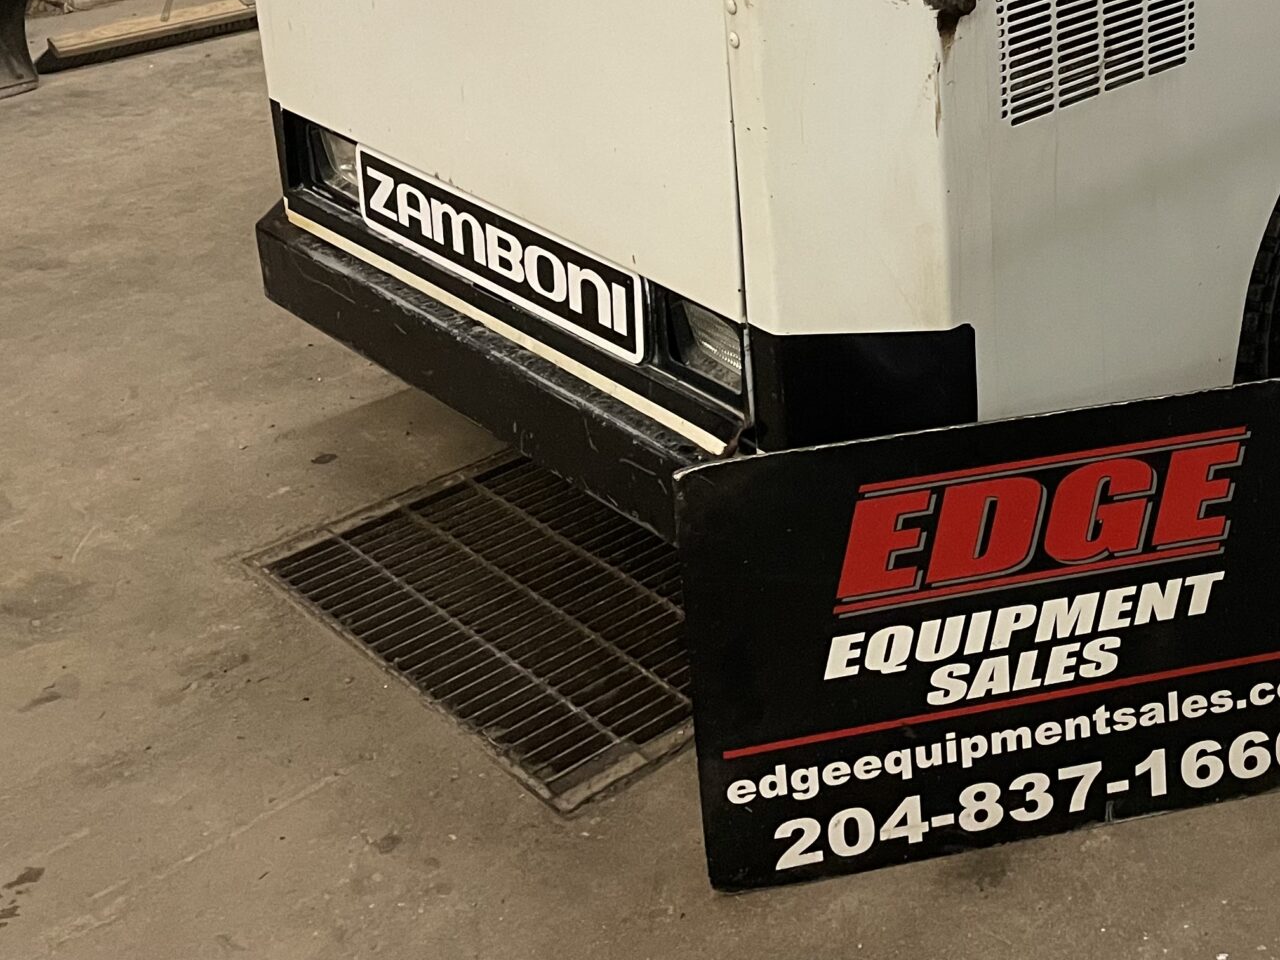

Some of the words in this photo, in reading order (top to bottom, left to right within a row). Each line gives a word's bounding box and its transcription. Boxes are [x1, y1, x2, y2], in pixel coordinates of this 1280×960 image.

[366, 166, 628, 335] ZAMBONI
[835, 442, 1244, 600] EDGE
[823, 571, 1225, 680] EQUIPMENT
[926, 637, 1122, 706] SALES
